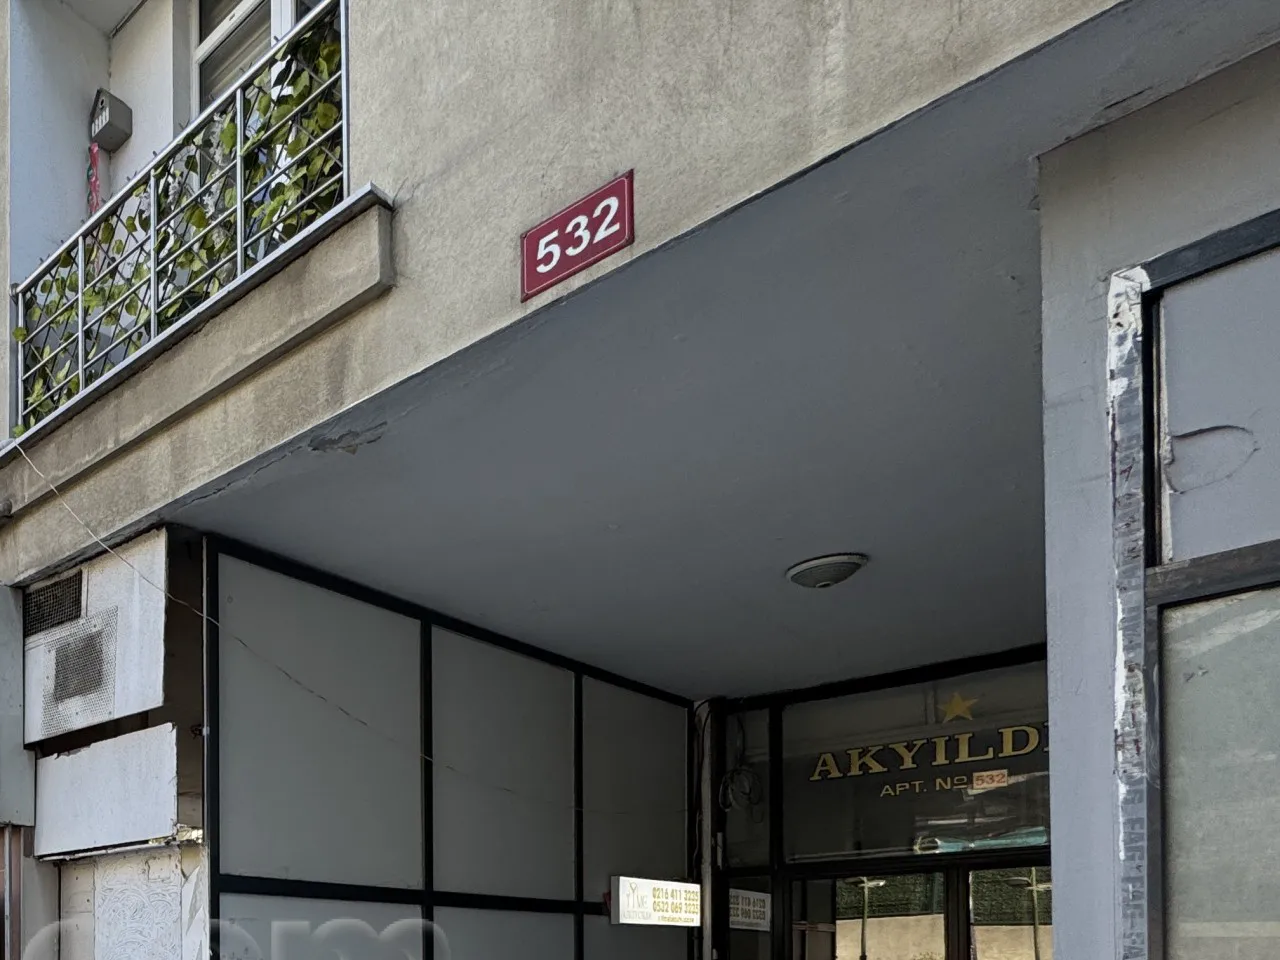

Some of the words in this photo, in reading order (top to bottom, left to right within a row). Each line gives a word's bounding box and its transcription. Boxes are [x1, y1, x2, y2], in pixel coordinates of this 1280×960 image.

[536, 196, 620, 273] 532
[809, 721, 1049, 781] AKYILD
[880, 780, 927, 797] APT.
[975, 772, 1006, 787] 532
